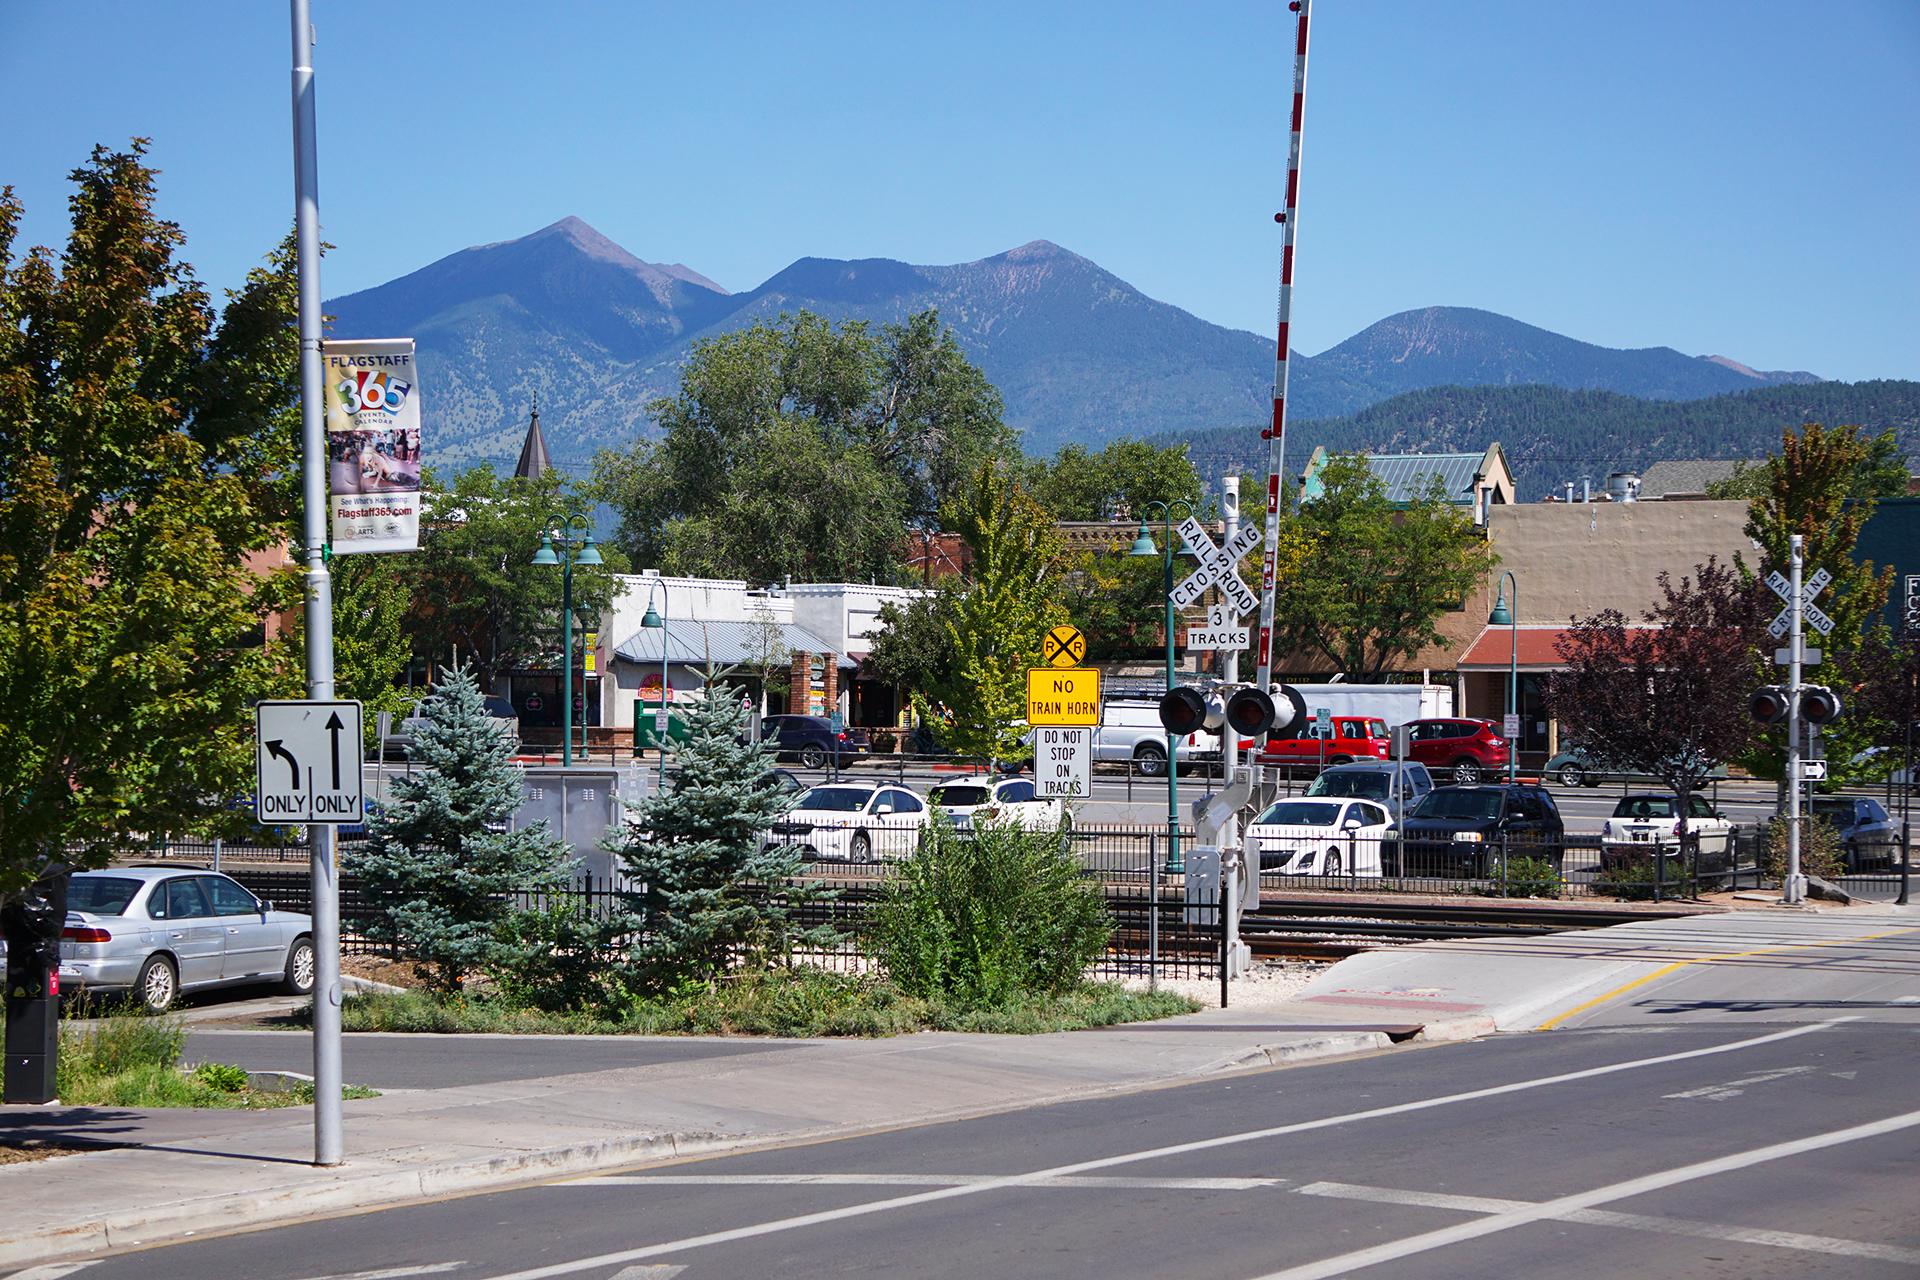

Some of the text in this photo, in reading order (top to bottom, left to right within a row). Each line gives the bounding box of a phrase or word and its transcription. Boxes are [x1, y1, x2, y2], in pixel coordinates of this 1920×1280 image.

[331, 355, 408, 367] FLAGSTAFF
[339, 370, 406, 414] 365
[354, 418, 393, 426] CALENDAR
[337, 507, 412, 519] Flagstaff365.com
[1174, 527, 1258, 605] CROSSING
[1180, 521, 1252, 610] RAIL ROAD
[1213, 611, 1223, 627] 3
[1190, 633, 1247, 644] TRACKS
[1045, 641, 1082, 652] R R
[1053, 680, 1074, 693] NO
[1032, 701, 1096, 715] TRAIN HORN
[1045, 730, 1082, 744] DO NOT
[1051, 747, 1075, 760] STOP
[1056, 764, 1070, 777] ON
[1044, 781, 1082, 794] TRACKS
[265, 795, 306, 813] ONLY
[316, 795, 357, 813] ONLY
